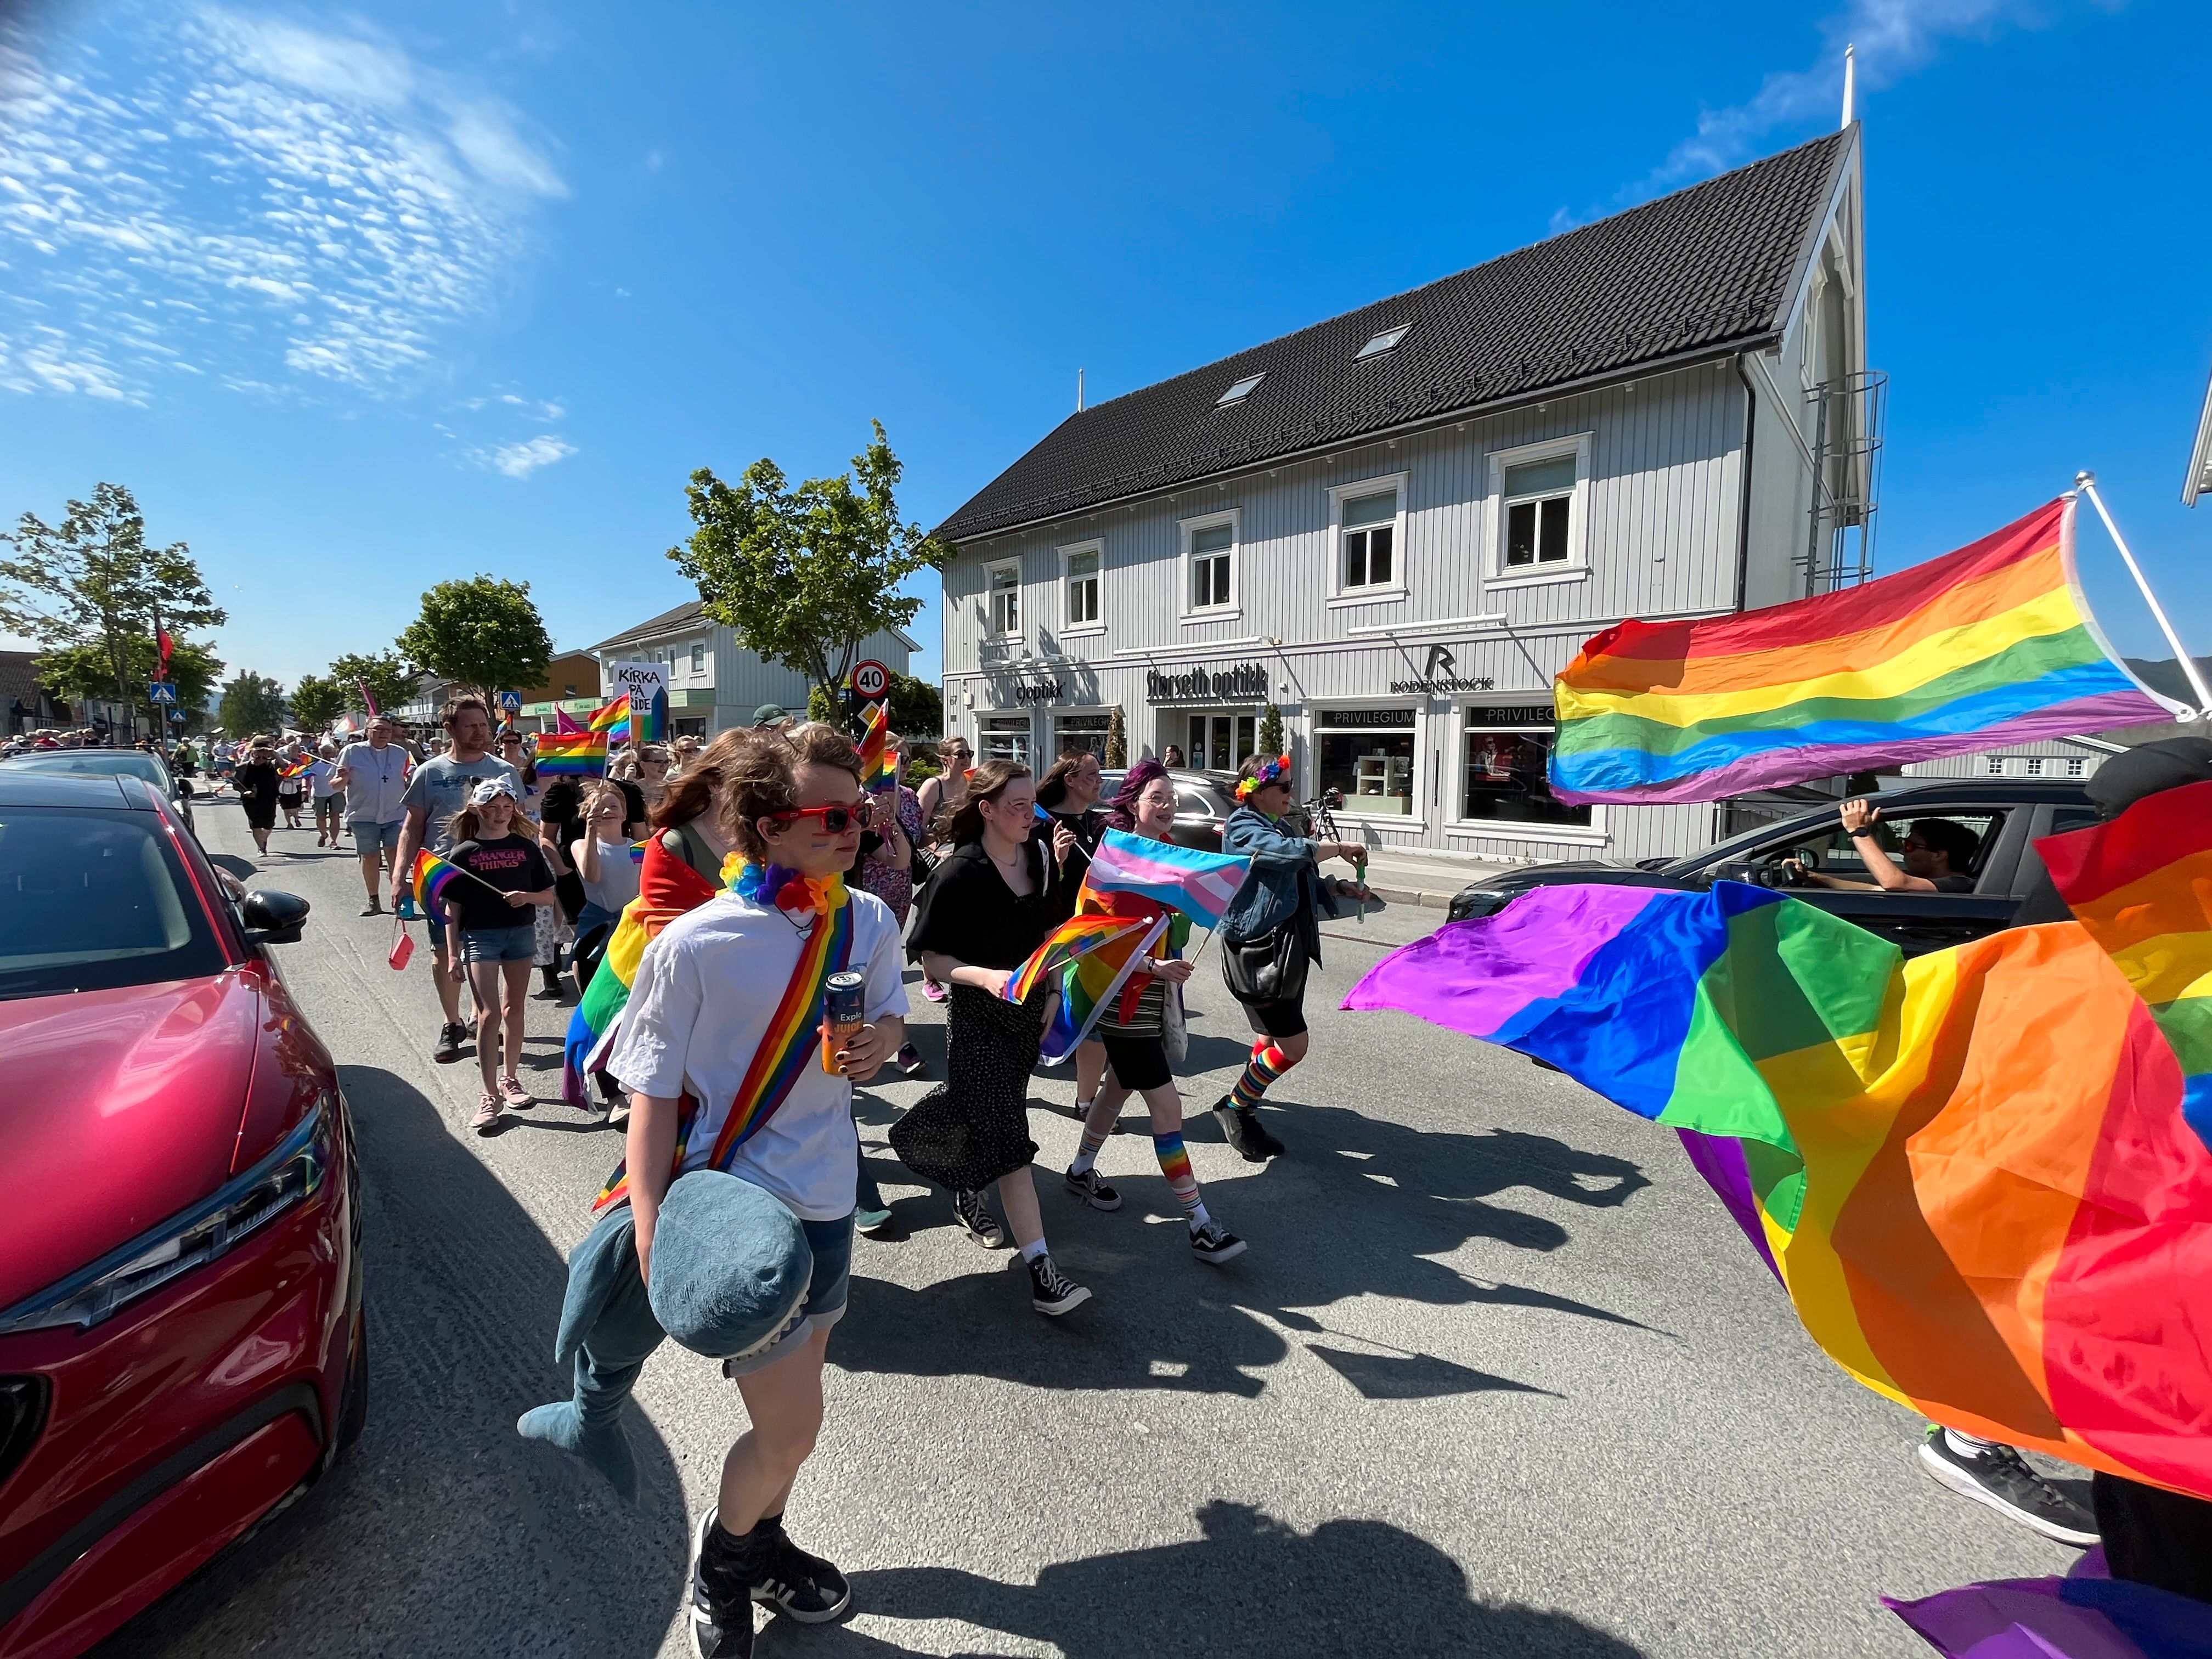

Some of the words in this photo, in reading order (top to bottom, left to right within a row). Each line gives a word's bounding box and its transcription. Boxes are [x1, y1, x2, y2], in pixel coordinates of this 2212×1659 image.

[859, 671, 882, 687] 40
[1212, 663, 1268, 699] optikk
[1390, 678, 1493, 694] RODENSTOCK
[1334, 712, 1414, 723] PRIVILEGIUM
[469, 850, 527, 866] STRANGER
[479, 859, 519, 871] THINGS
